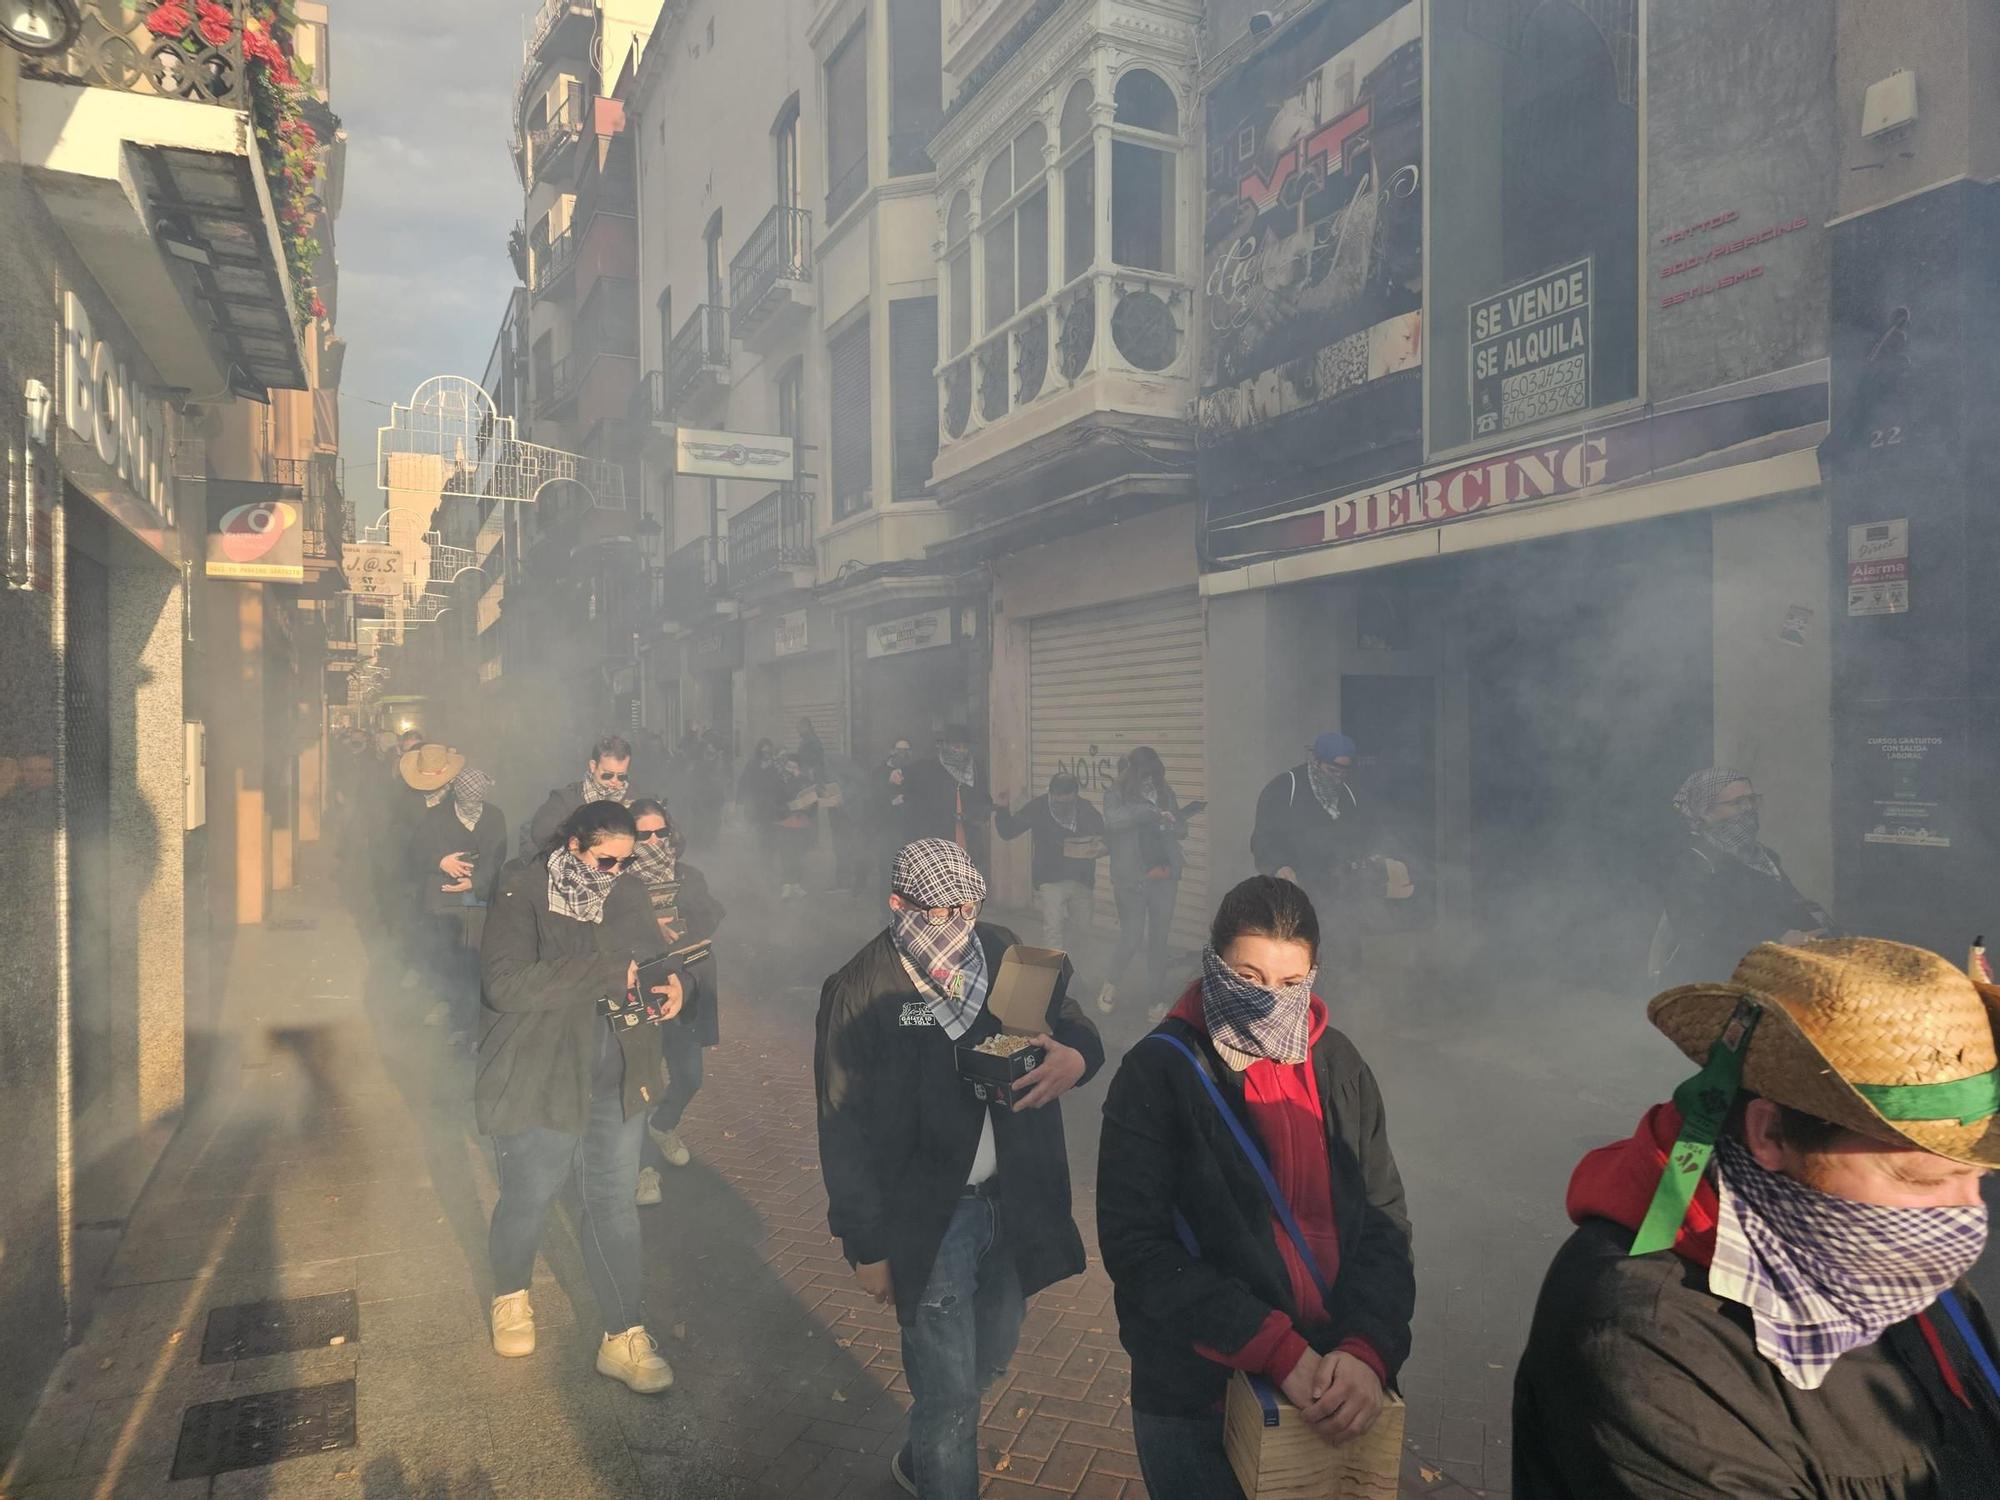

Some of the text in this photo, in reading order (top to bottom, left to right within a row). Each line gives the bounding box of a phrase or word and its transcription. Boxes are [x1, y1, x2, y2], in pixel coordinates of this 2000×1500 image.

[1659, 208, 1742, 245] TATTOO
[1659, 216, 1809, 280] BODYPIERCING
[1476, 271, 1583, 339] SE VENDE
[1660, 263, 1766, 309] ESTILISMO
[1477, 317, 1584, 380] SE ALQUILA
[1503, 358, 1583, 402] 660324539
[1871, 426, 1901, 449] 22
[1321, 437, 1609, 542] PIERCING
[1852, 562, 1905, 577] Alarma
[1867, 736, 1943, 745] CURSOS GRATUITOS
[1881, 744, 1898, 752] CON
